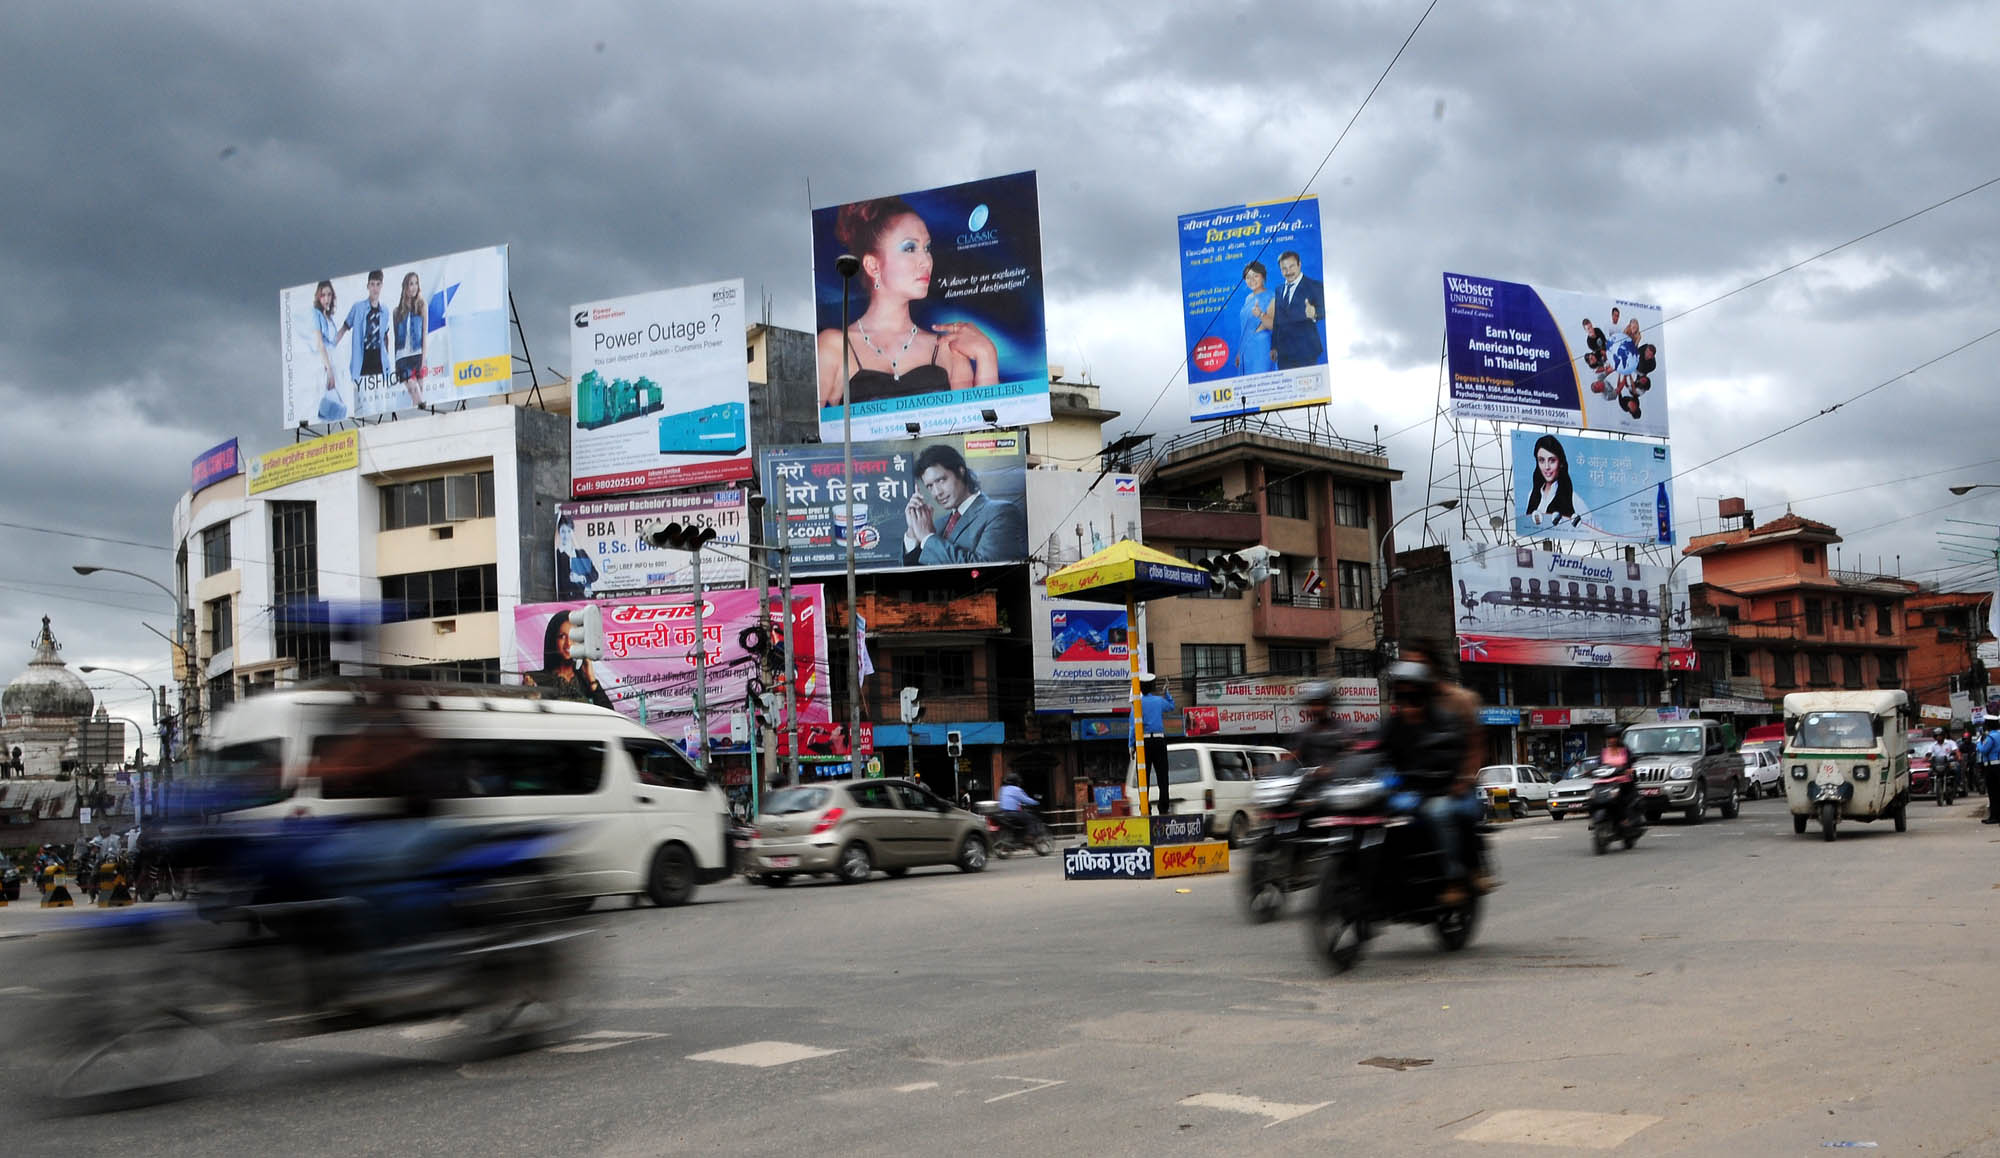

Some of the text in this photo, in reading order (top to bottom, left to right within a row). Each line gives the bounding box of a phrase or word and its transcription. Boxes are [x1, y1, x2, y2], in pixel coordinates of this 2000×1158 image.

[956, 229, 998, 245] CLASSIC
[950, 276, 968, 287] door
[970, 275, 978, 285] to
[980, 274, 990, 282] an
[992, 268, 1026, 280] exclusive
[945, 285, 978, 299] diamond
[1447, 277, 1494, 297] Webster
[1450, 293, 1494, 308] UNIVERSITY
[594, 313, 721, 352] Power Outage ?
[1485, 325, 1532, 343] Earn Your
[703, 339, 723, 350] Power
[1468, 339, 1550, 361] American Degree
[459, 363, 482, 380] ufo
[1484, 355, 1537, 373] in Thailand
[849, 402, 888, 417] LASSIC
[896, 393, 953, 410] DIAMOND
[961, 385, 1025, 402] JEWELLERS
[1213, 389, 1232, 402] LIC
[1456, 402, 1482, 410] Contact:
[576, 480, 594, 492] Call:
[595, 475, 646, 490] 9802025100
[580, 504, 590, 515] Go
[591, 503, 603, 514] for
[604, 501, 628, 513] Power
[629, 497, 671, 511] Bachelor's
[672, 495, 701, 508] Degree
[587, 521, 616, 537] BBA
[682, 511, 740, 528] BSc.(IT)
[599, 540, 631, 554] B.Sc.
[608, 623, 669, 657] सुन्दरी
[1110, 646, 1127, 654] VISA
[1053, 667, 1130, 679] Accepted Globally
[1226, 685, 1252, 696] NABIL
[1255, 685, 1287, 696] SAVING
[1165, 819, 1186, 839] ट्राफिक
[1066, 846, 1151, 876] ट्राफिक प्रहरी
